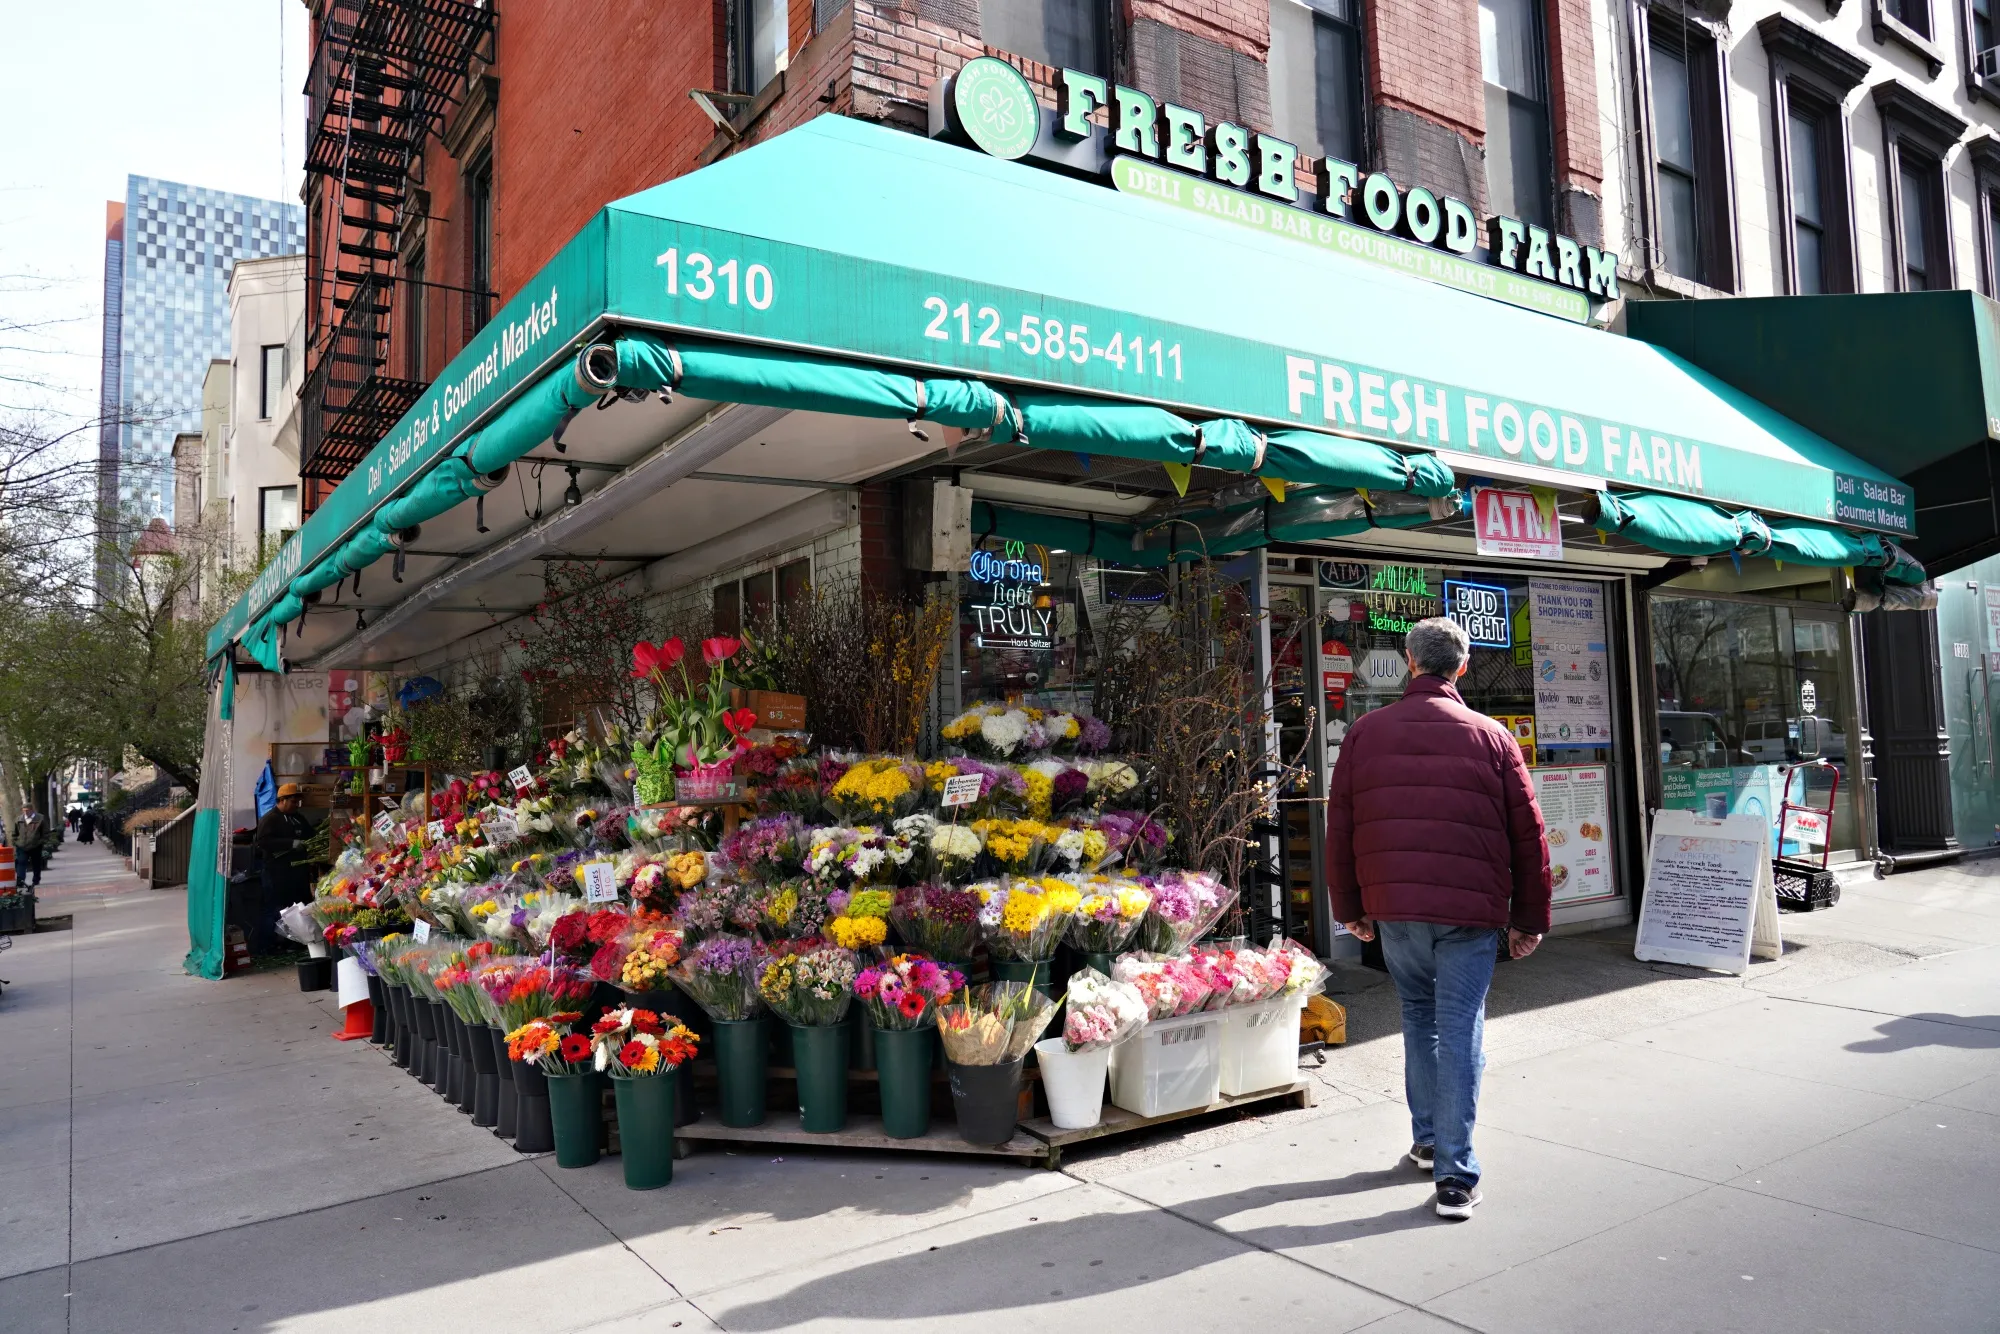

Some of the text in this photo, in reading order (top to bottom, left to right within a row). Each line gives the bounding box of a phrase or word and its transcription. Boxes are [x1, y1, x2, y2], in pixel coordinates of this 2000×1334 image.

[958, 63, 1037, 125] FRESH FOOD FARM
[1063, 67, 1620, 300] FRESH FOOD FARM
[1127, 166, 1180, 201] DELI
[1192, 186, 1265, 225] SALAD
[1270, 208, 1312, 239] BAR
[1317, 224, 1333, 244] &
[1337, 229, 1425, 274] GOURMET
[1429, 261, 1497, 291] MARKET
[1507, 282, 1528, 297] 212
[656, 247, 773, 310] 1310
[923, 296, 1182, 380] 212-585-4111
[368, 285, 558, 496] Deli Salad Bar & Gourmet Market
[1286, 355, 1703, 489] FRESH FOOD FARM
[1836, 476, 1906, 506] Deli Salad Bar
[1486, 492, 1552, 542] ATM
[1826, 498, 1907, 529] & Gourmet Market
[281, 531, 303, 583] FARM
[970, 551, 1042, 584] Corona
[1328, 562, 1360, 581] ATM
[1530, 581, 1552, 590] WELCOME
[1364, 592, 1436, 617] NEW YORK
[1456, 587, 1498, 616] BUD
[1537, 594, 1593, 608] THANK YOU FOR
[1538, 606, 1593, 619] SHOPPING HERE
[971, 605, 1051, 636] TRULY
[1368, 611, 1418, 634] Heineke
[1011, 638, 1052, 648] Hard Seltzer
[1553, 641, 1580, 652] four
[1372, 658, 1398, 678] JUUL
[1539, 691, 1560, 704] Modelo
[1567, 695, 1583, 705] TRULY
[1587, 724, 1597, 736] Lite
[1543, 773, 1568, 783] QUESADILLA
[1667, 775, 1678, 783] Pick
[1673, 783, 1691, 791] Delivery
[1677, 790, 1697, 798] Available
[1584, 848, 1597, 857] SIDES
[1687, 859, 1706, 867] French
[592, 868, 602, 898] ROSES
